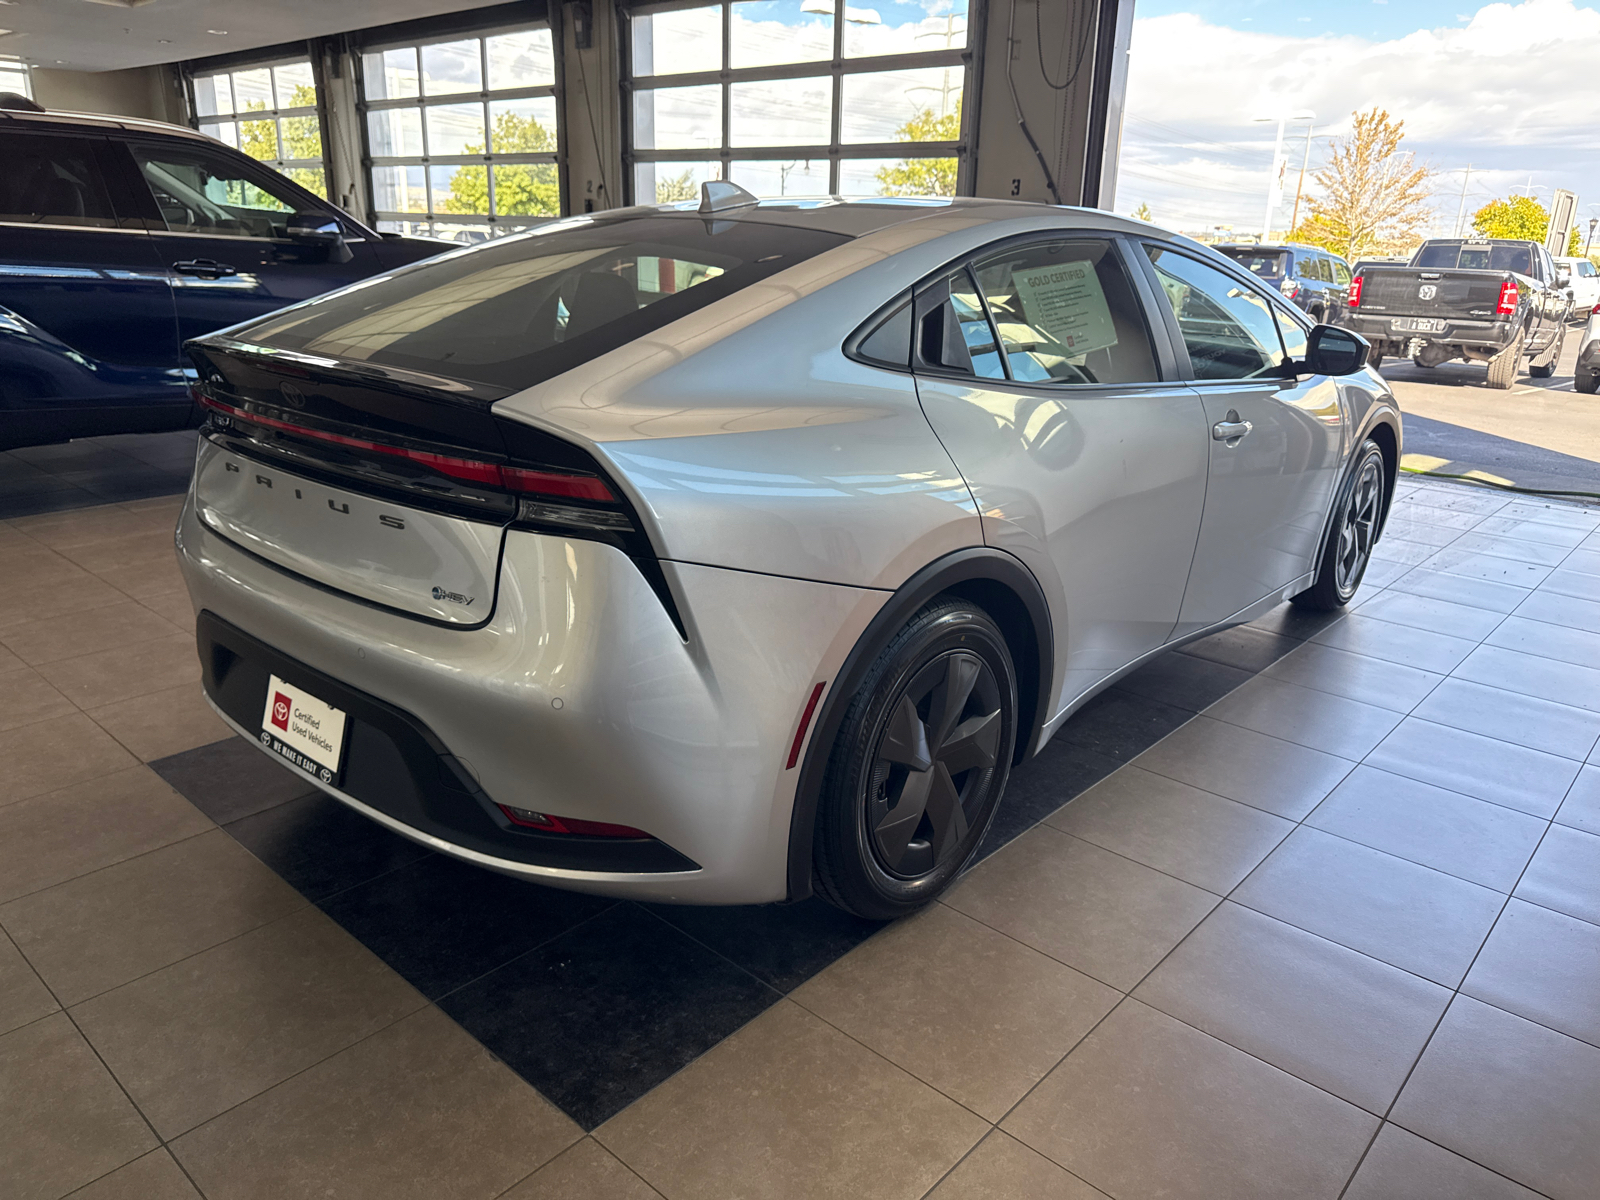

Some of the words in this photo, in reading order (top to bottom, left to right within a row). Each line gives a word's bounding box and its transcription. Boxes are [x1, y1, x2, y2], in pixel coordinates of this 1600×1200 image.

[586, 179, 593, 193] 2
[1011, 178, 1021, 197] 3
[1028, 275, 1050, 288] GOLD
[1050, 269, 1086, 283] CERTIFIED
[225, 462, 405, 530] PRIUS
[441, 590, 475, 606] HEV
[294, 708, 320, 730] Certified
[292, 721, 308, 738] Used
[308, 730, 333, 753] Vehicles
[273, 740, 282, 753] WE
[282, 745, 297, 762] MAKE
[302, 758, 317, 775] EASY
